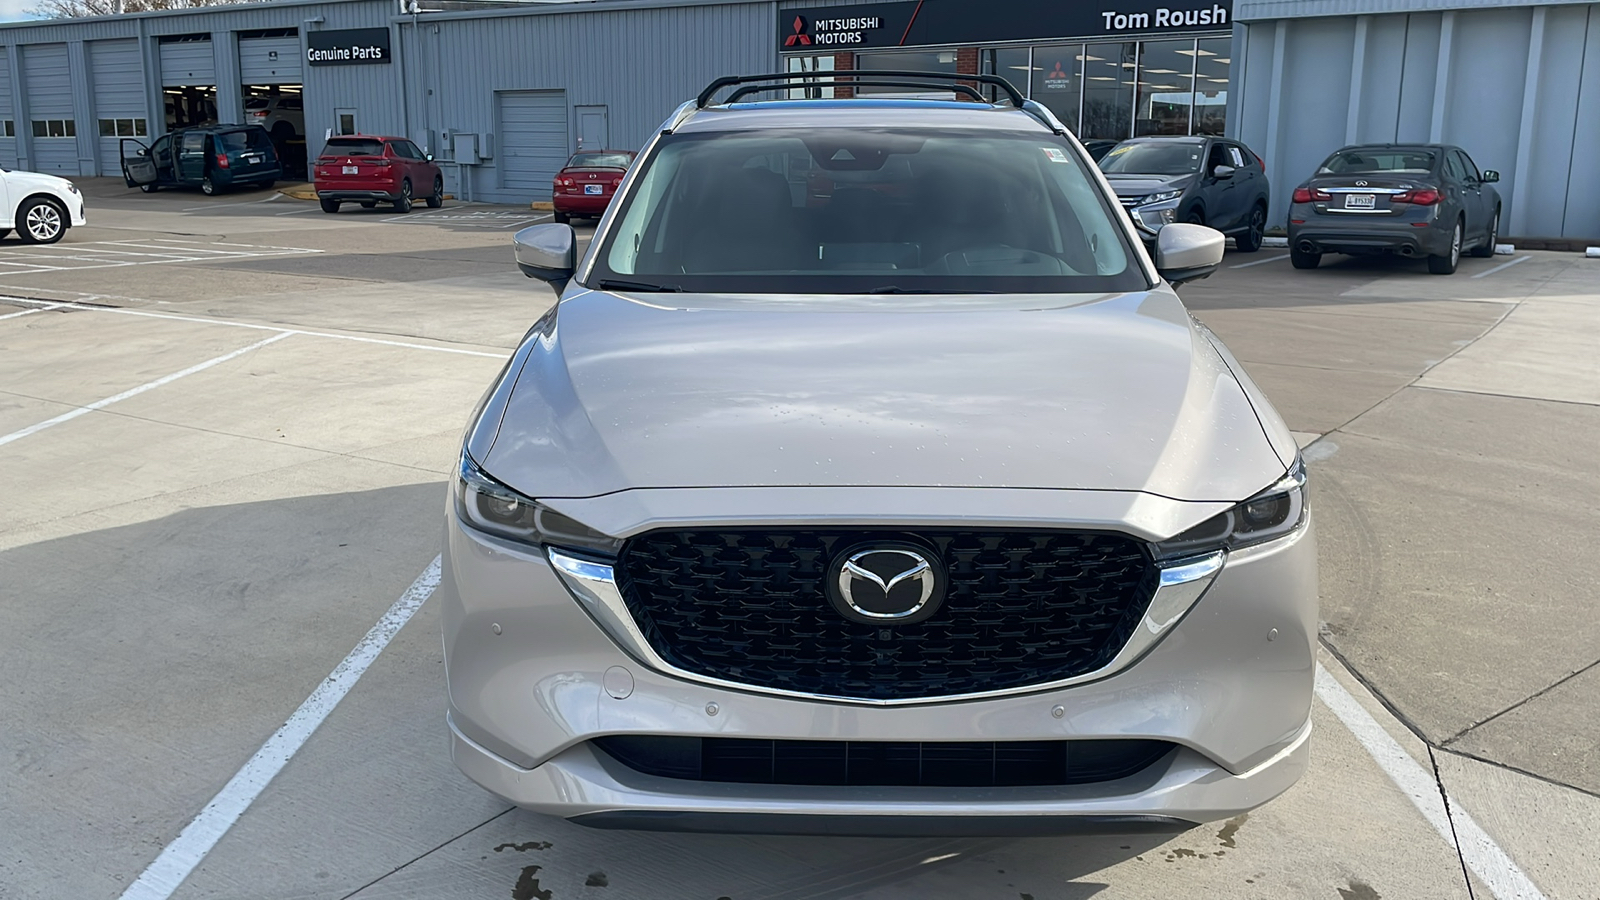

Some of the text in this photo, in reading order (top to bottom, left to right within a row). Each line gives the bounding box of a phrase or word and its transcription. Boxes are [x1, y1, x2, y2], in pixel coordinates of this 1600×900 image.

[815, 17, 879, 31] MITSUBISHI
[1102, 4, 1226, 30] Tom Roush
[815, 32, 862, 44] MOTORS
[307, 45, 382, 61] Genuine Parts
